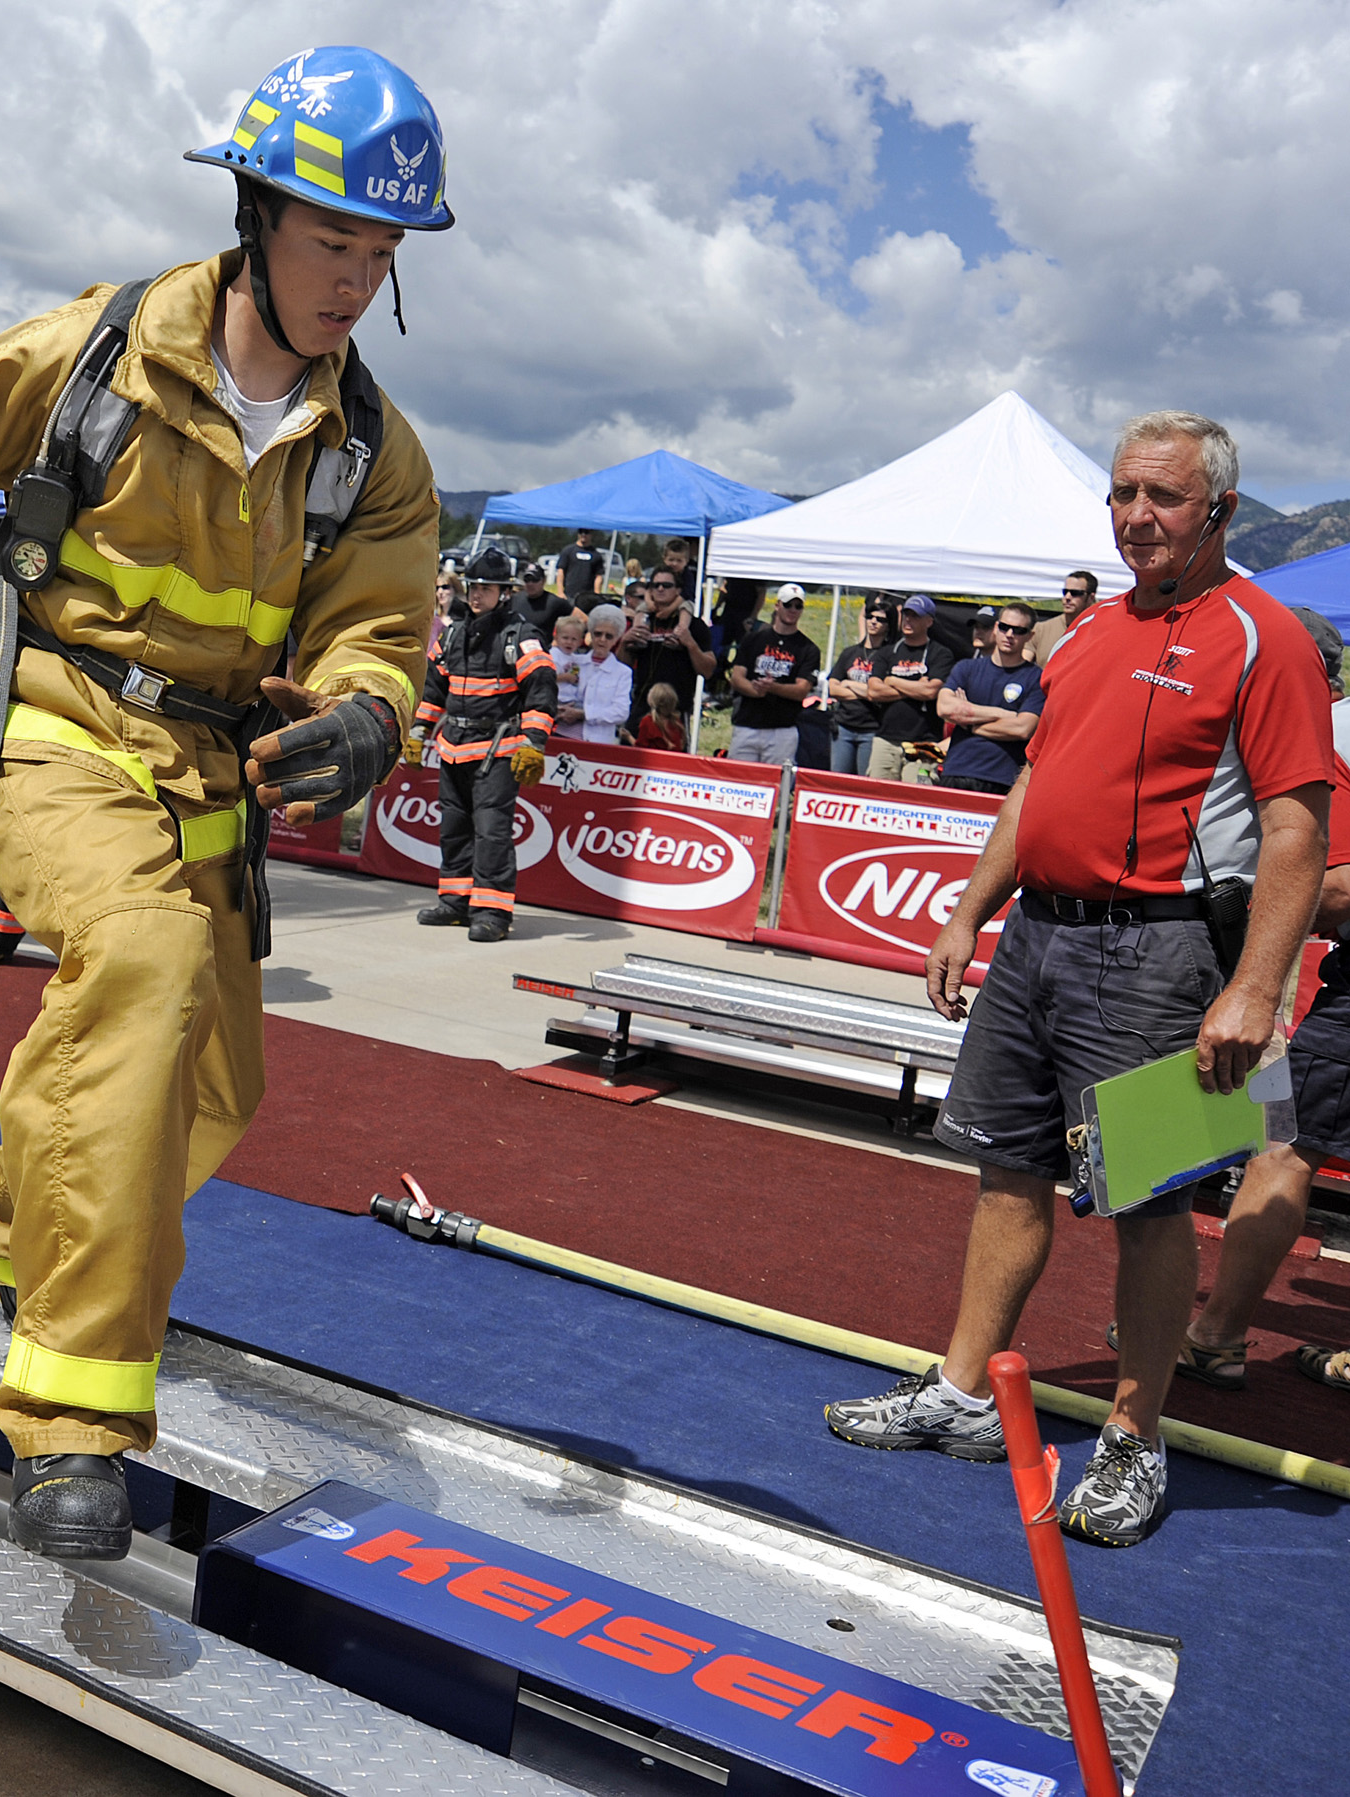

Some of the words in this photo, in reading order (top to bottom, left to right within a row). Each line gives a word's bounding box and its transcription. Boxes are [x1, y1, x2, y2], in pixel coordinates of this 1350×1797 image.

[261, 74, 284, 95] US
[296, 95, 333, 120] AF
[589, 768, 643, 792] SCOTT
[646, 774, 717, 792] FIREFIGHTER
[719, 786, 767, 800] COMBAT
[643, 782, 768, 812] CHALLENGE
[803, 798, 861, 823] SCOTT
[866, 804, 943, 823] FIREFIGHTER
[564, 810, 726, 874] jostens
[342, 1529, 936, 1765] KEISER
